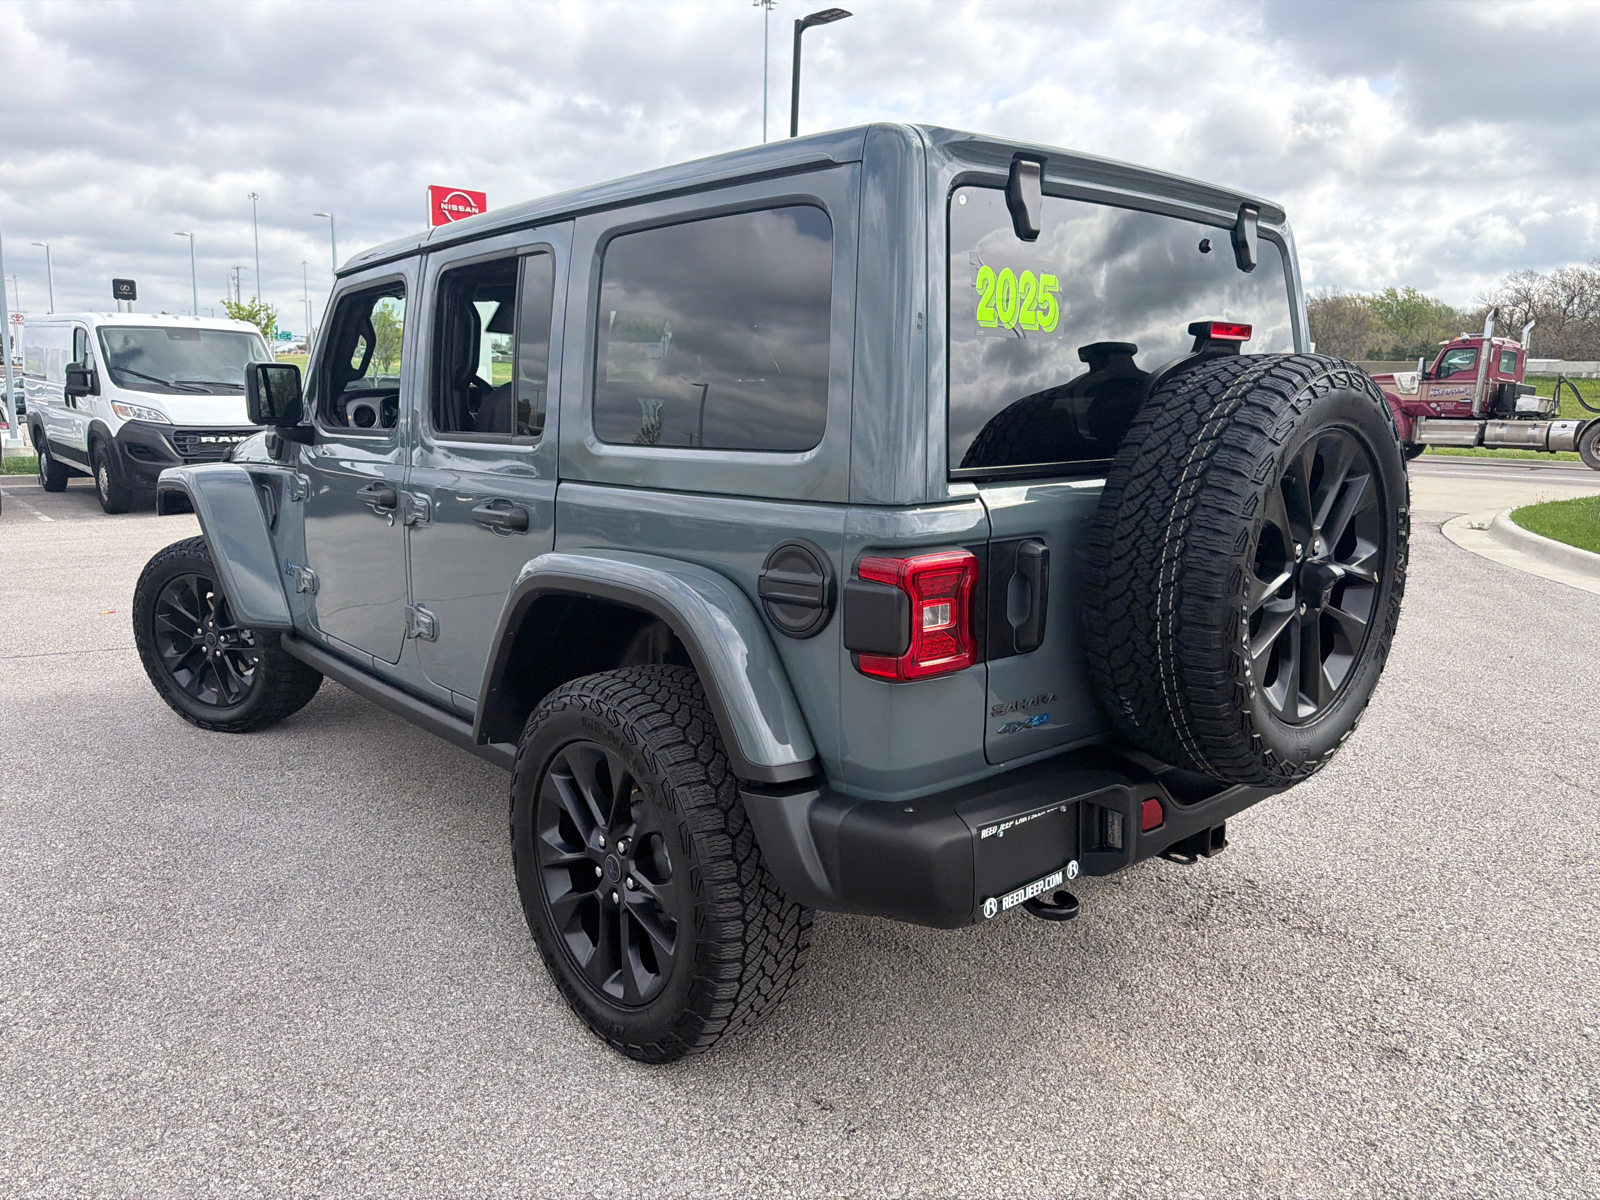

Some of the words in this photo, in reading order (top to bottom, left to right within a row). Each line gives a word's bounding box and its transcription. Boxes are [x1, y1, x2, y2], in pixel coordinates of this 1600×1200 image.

[441, 203, 479, 214] NISSAN
[976, 265, 1060, 333] 2025
[991, 692, 1057, 717] SAHARA
[981, 825, 998, 840] REED
[1002, 871, 1063, 911] REEDJEEP.COM
